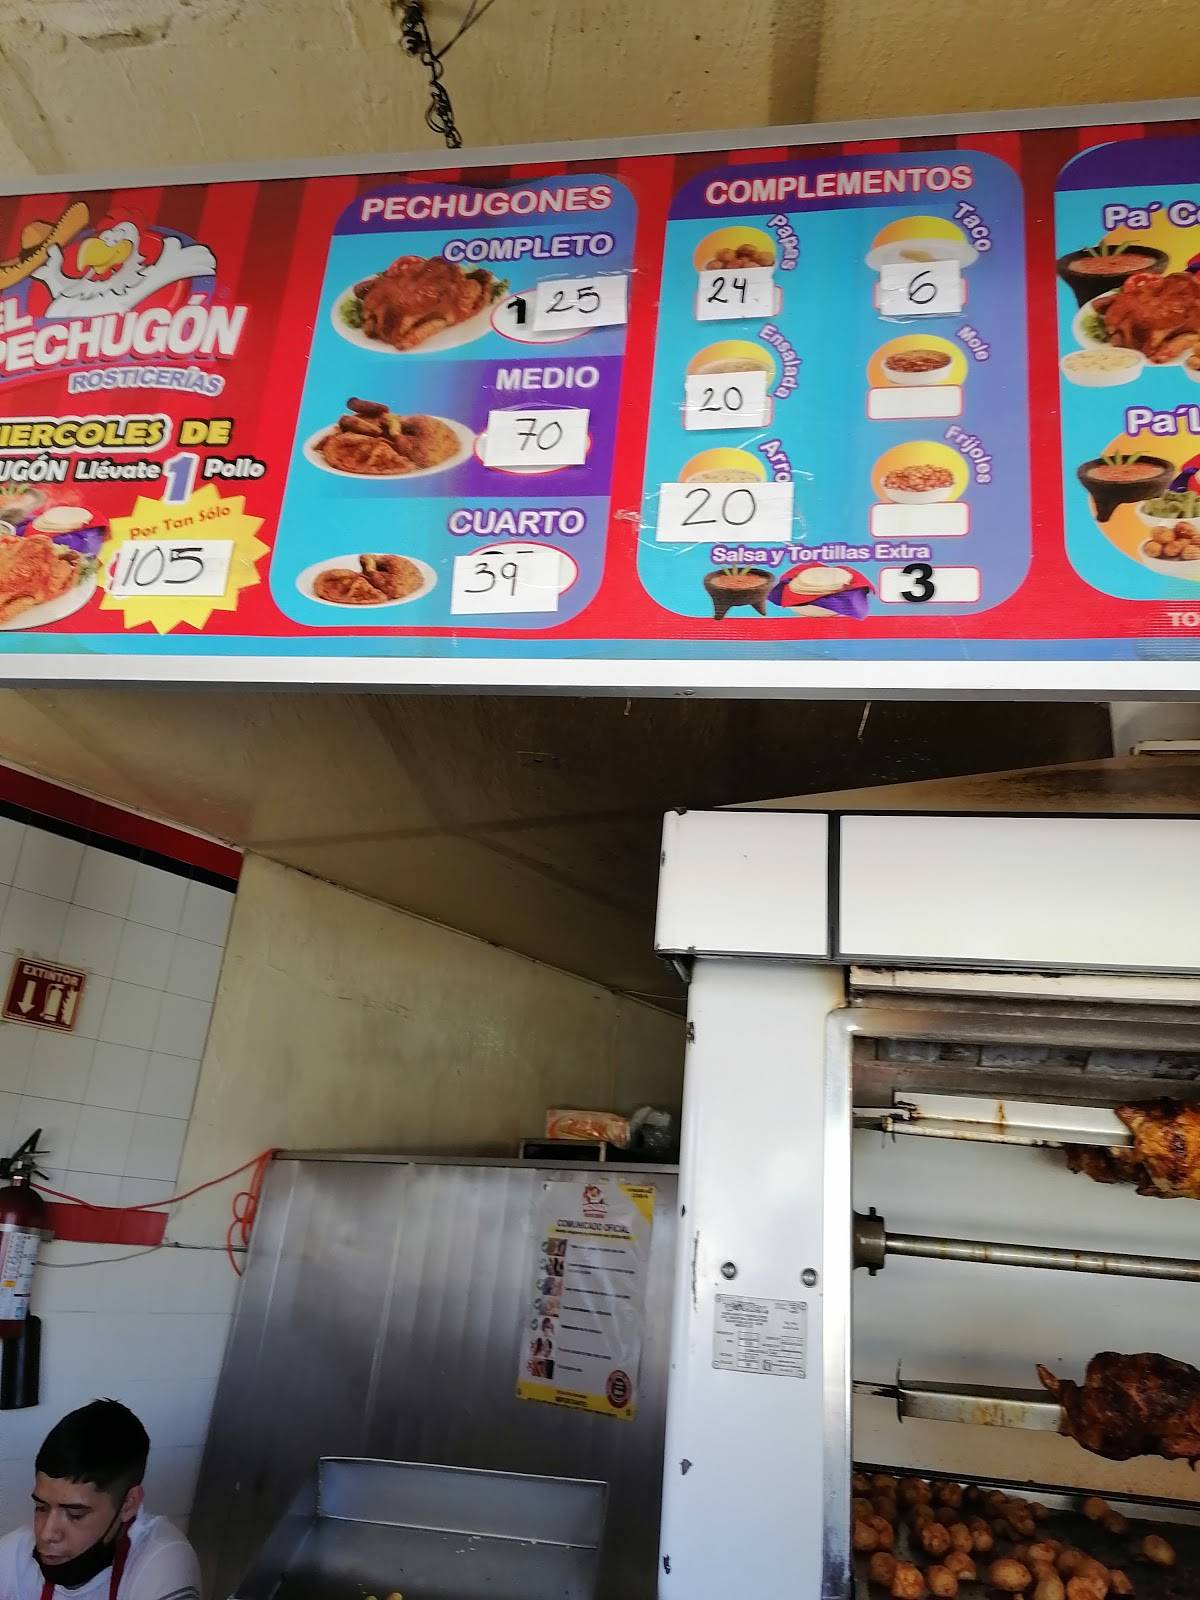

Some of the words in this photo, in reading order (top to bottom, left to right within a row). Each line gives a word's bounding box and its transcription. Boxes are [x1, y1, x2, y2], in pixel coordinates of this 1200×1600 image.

[706, 164, 973, 206] COMPLEMENTOS
[361, 185, 613, 222] PECHUGONES
[1168, 200, 1200, 227] C
[767, 213, 800, 271] Papas
[953, 201, 992, 252] Taco
[443, 233, 614, 262] COMPLETO
[707, 276, 748, 304] 24
[908, 270, 937, 305] 6
[0, 297, 34, 333] L
[0, 294, 248, 372] ECHUGÓN
[758, 324, 802, 399] Ensalada
[957, 325, 990, 362] Mole
[70, 368, 222, 395] ROSTICERÍAS
[495, 365, 600, 391] MEDIO
[699, 386, 743, 412] 20
[0, 419, 165, 447] IERCOLES
[178, 420, 233, 446] DE
[515, 417, 563, 451] 70
[945, 425, 992, 484] Frijoles
[75, 459, 161, 481] Llévate
[165, 453, 200, 504] 1
[203, 457, 266, 479] Pollo
[130, 525, 158, 541] Por
[163, 516, 195, 531] Tan
[198, 504, 232, 523] Sólo
[449, 509, 585, 535] CUARTO
[681, 487, 757, 527] 20
[121, 545, 205, 588] 105
[712, 547, 768, 563] Salsa
[772, 551, 784, 567] y
[788, 545, 870, 562] Tortillas
[875, 544, 931, 560] Extra
[463, 561, 518, 597] 39
[900, 562, 936, 603] 3
